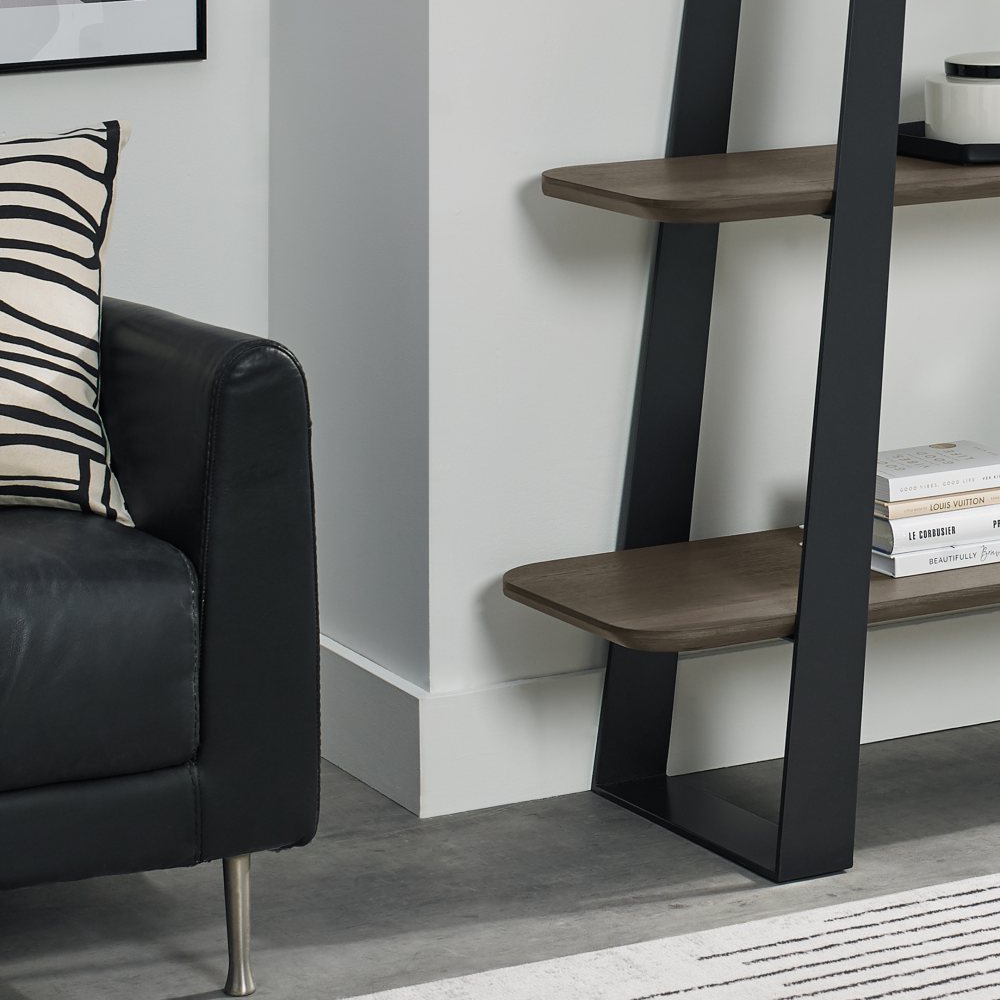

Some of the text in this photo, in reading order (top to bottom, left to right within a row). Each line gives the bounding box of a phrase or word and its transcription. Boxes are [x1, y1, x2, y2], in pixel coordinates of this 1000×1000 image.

[899, 486, 918, 494] GOOD
[942, 479, 961, 487] GOOD
[929, 502, 952, 512] LOUIS
[953, 496, 986, 509] VUITTON
[908, 526, 956, 541] LE CORBUSIER
[928, 552, 977, 565] BEAUTIFULLY
